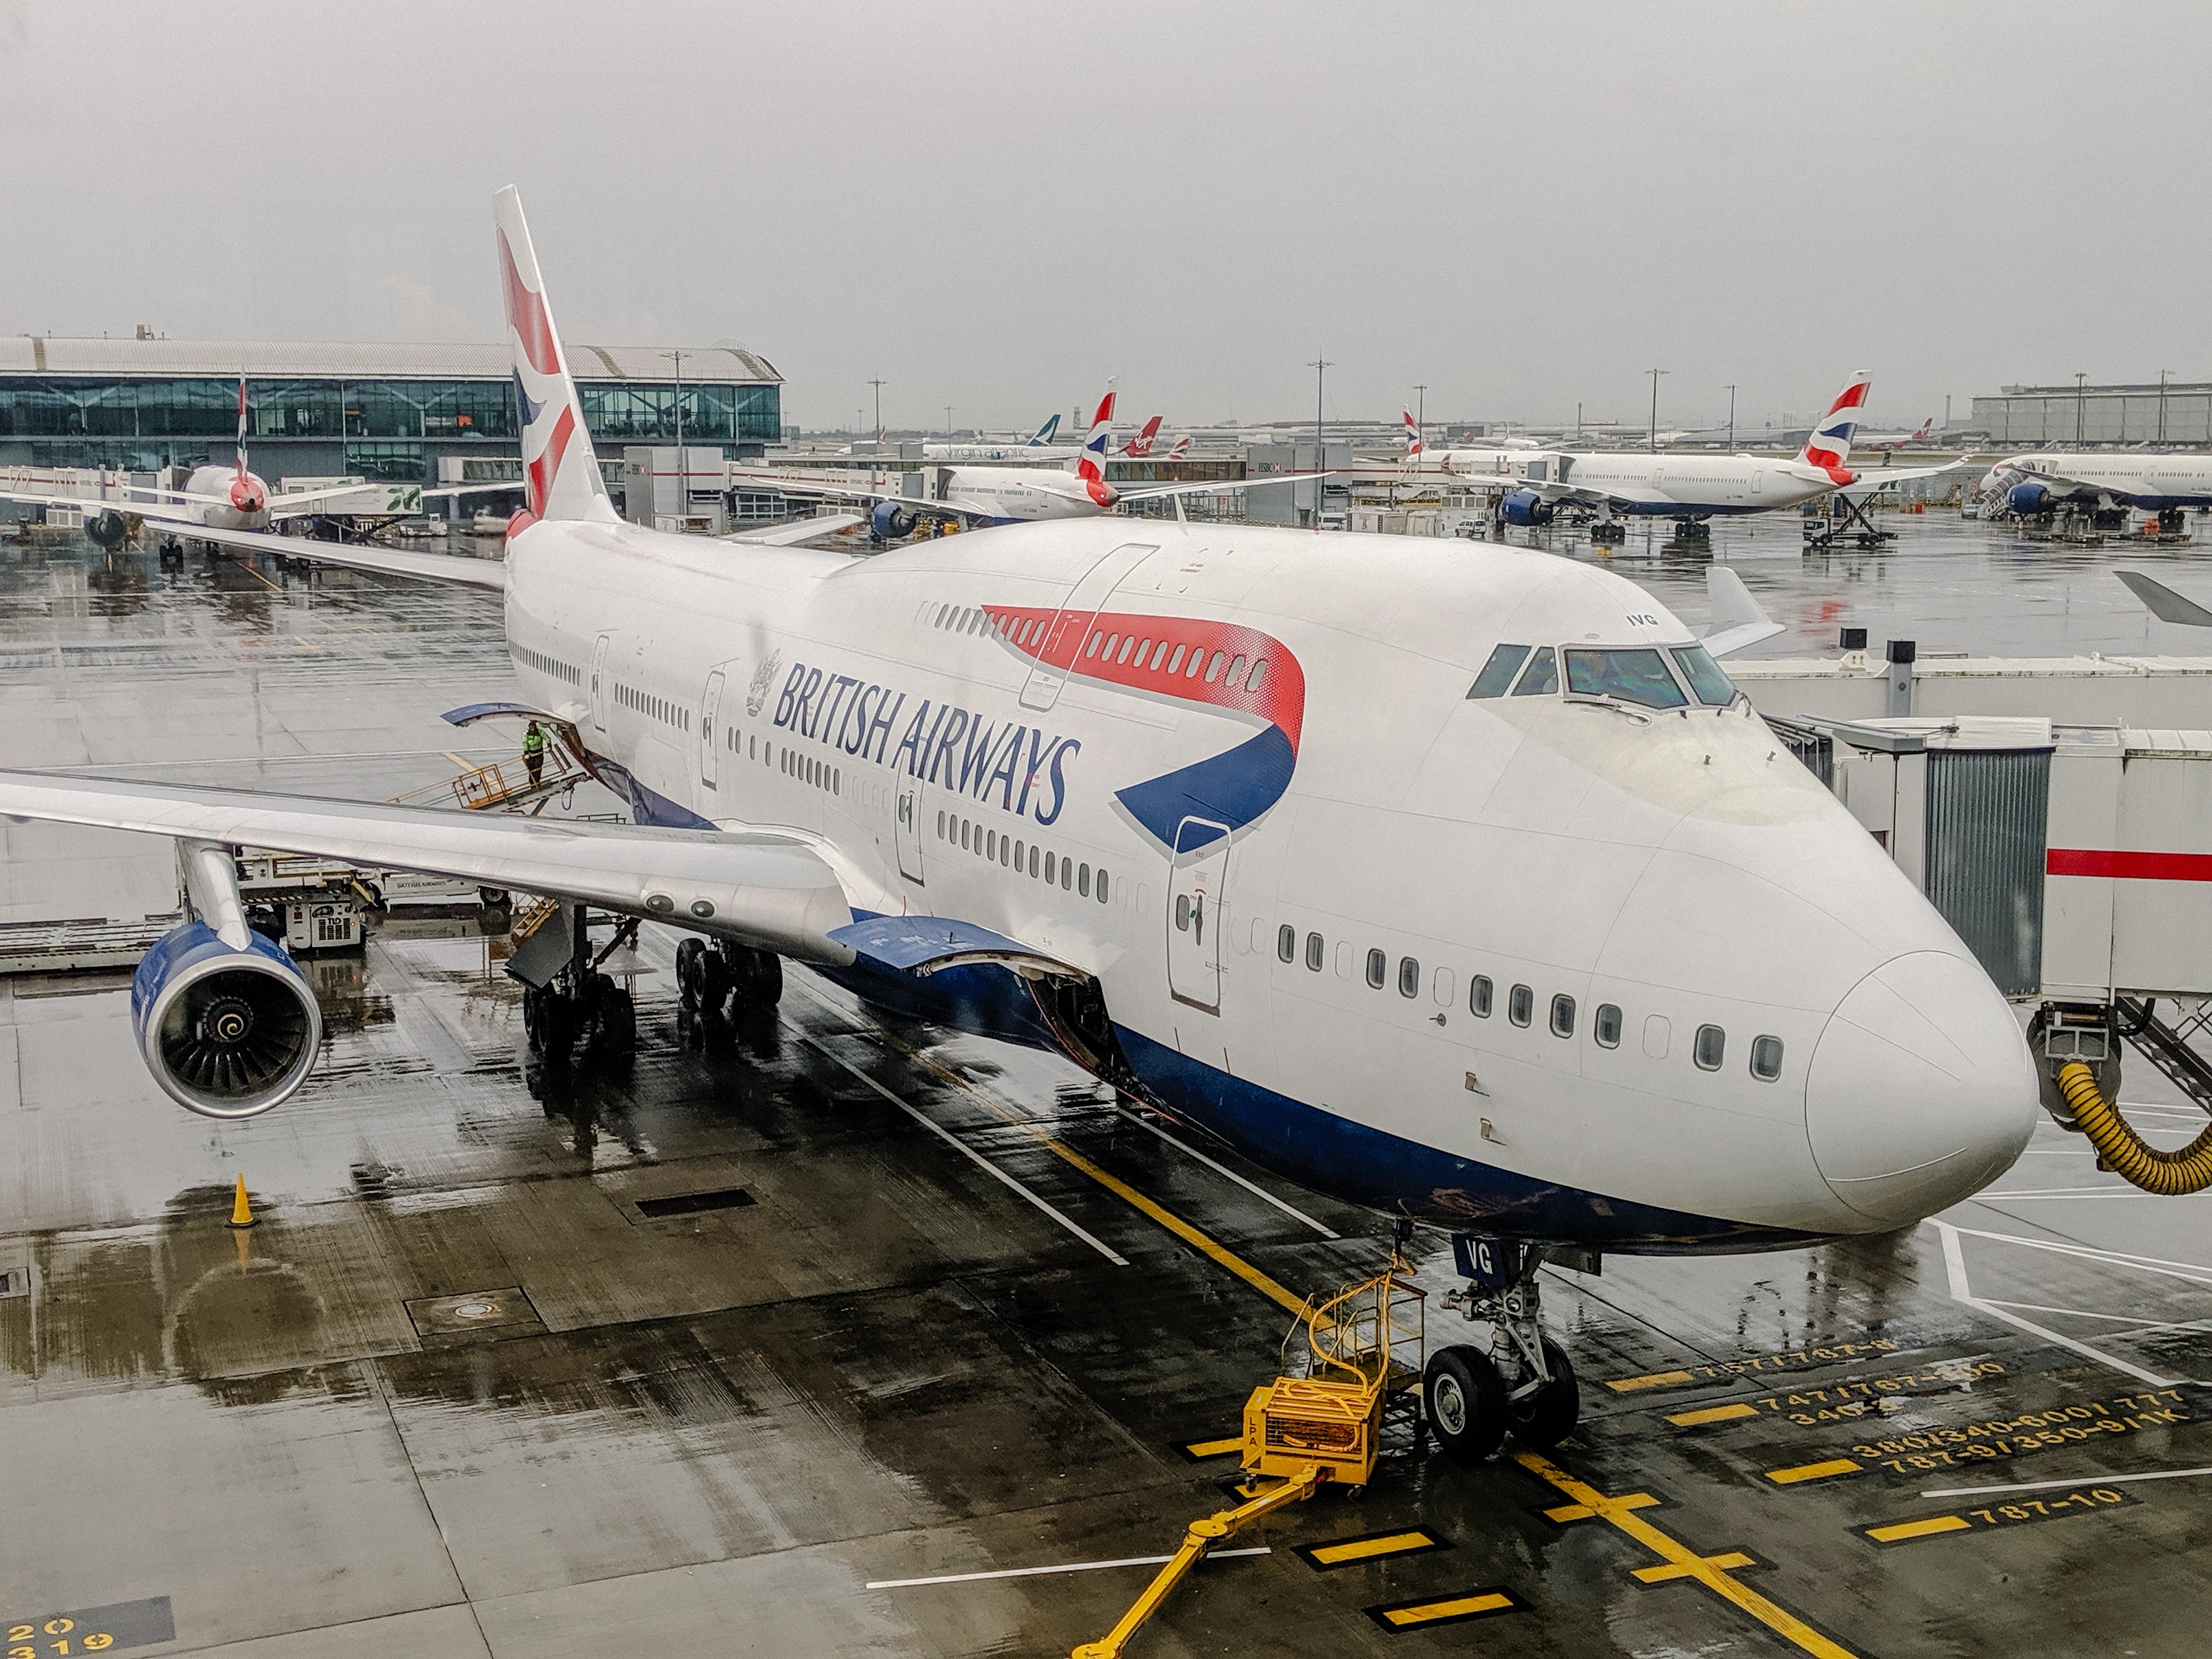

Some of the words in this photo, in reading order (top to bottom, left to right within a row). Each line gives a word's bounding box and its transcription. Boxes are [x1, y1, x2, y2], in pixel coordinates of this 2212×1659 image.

[1626, 614, 1659, 627] IVG
[773, 662, 907, 765] BRITISH
[890, 699, 1082, 826] AIRWAYS
[1465, 1239, 1493, 1274] VG
[1969, 1488, 2121, 1523] 787-10
